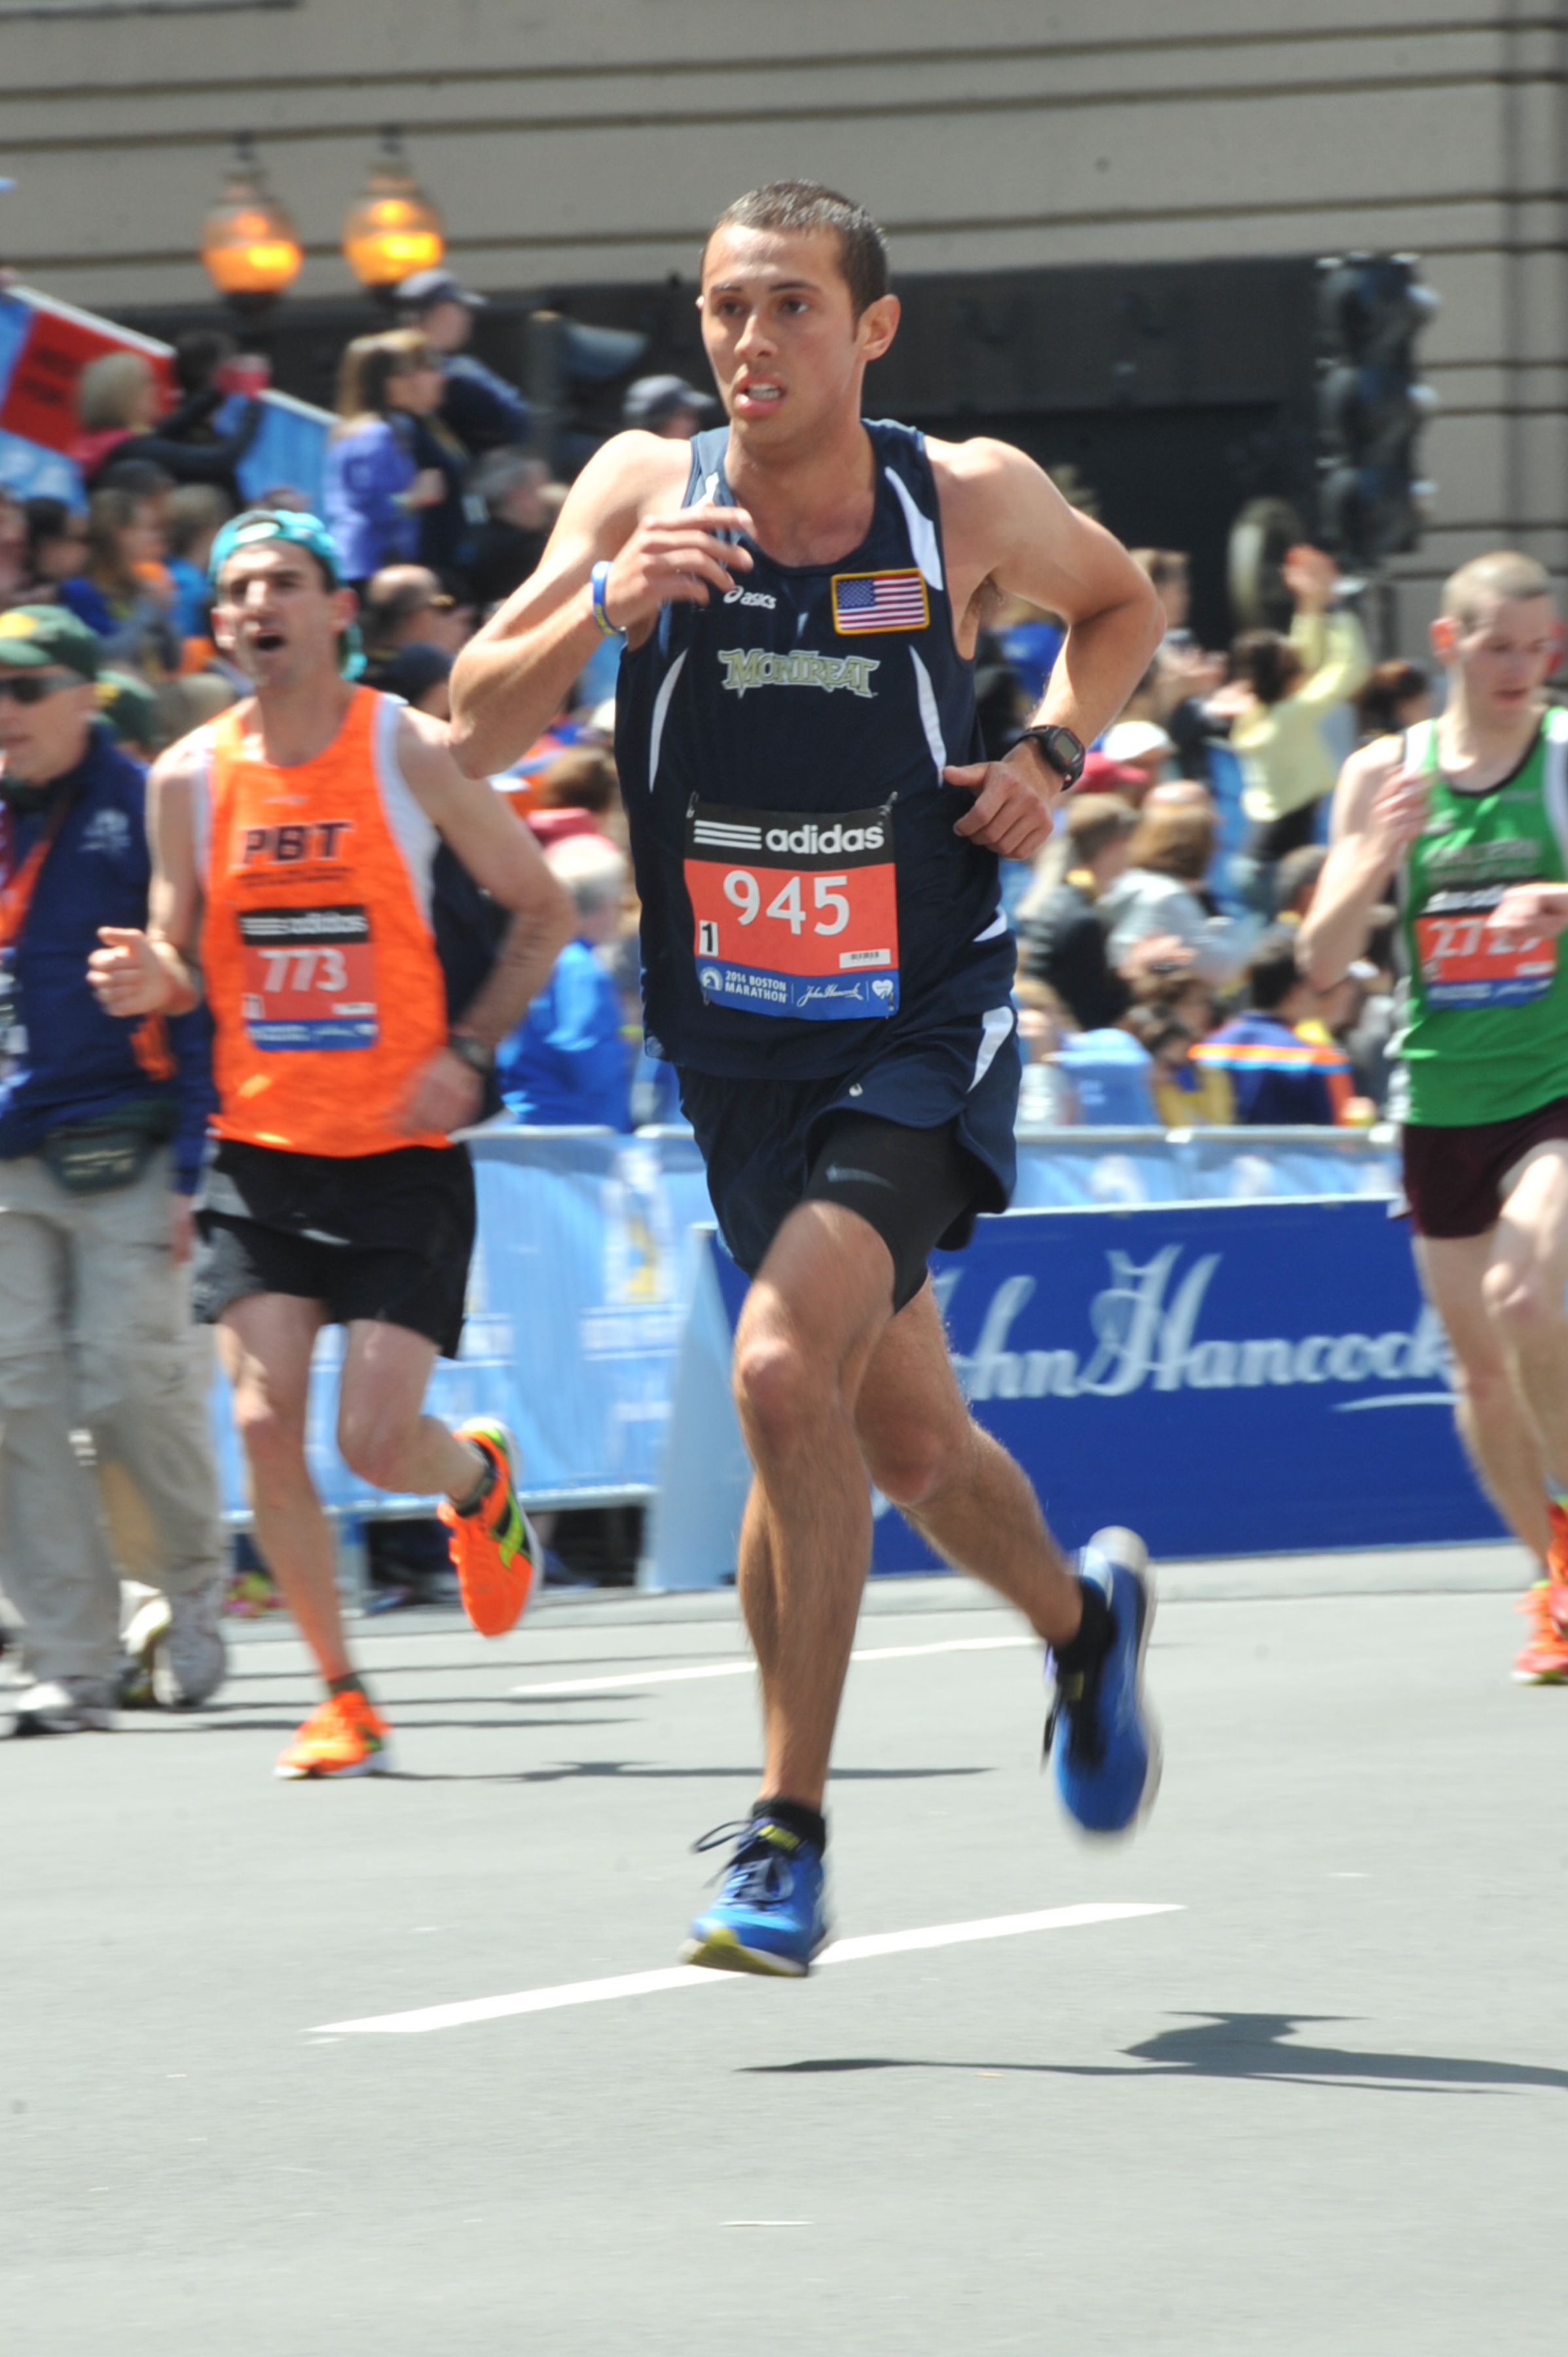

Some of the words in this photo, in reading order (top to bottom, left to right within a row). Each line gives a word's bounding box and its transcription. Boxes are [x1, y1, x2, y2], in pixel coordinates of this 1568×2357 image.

[740, 589, 777, 610] asics
[238, 820, 354, 866] PBT
[765, 824, 885, 854] adidas
[723, 869, 850, 936] 945
[701, 922, 714, 953] 1
[258, 947, 348, 993] 773
[725, 970, 746, 984] 2014
[749, 976, 786, 992] BOSTON
[725, 981, 787, 1004] MARATHON
